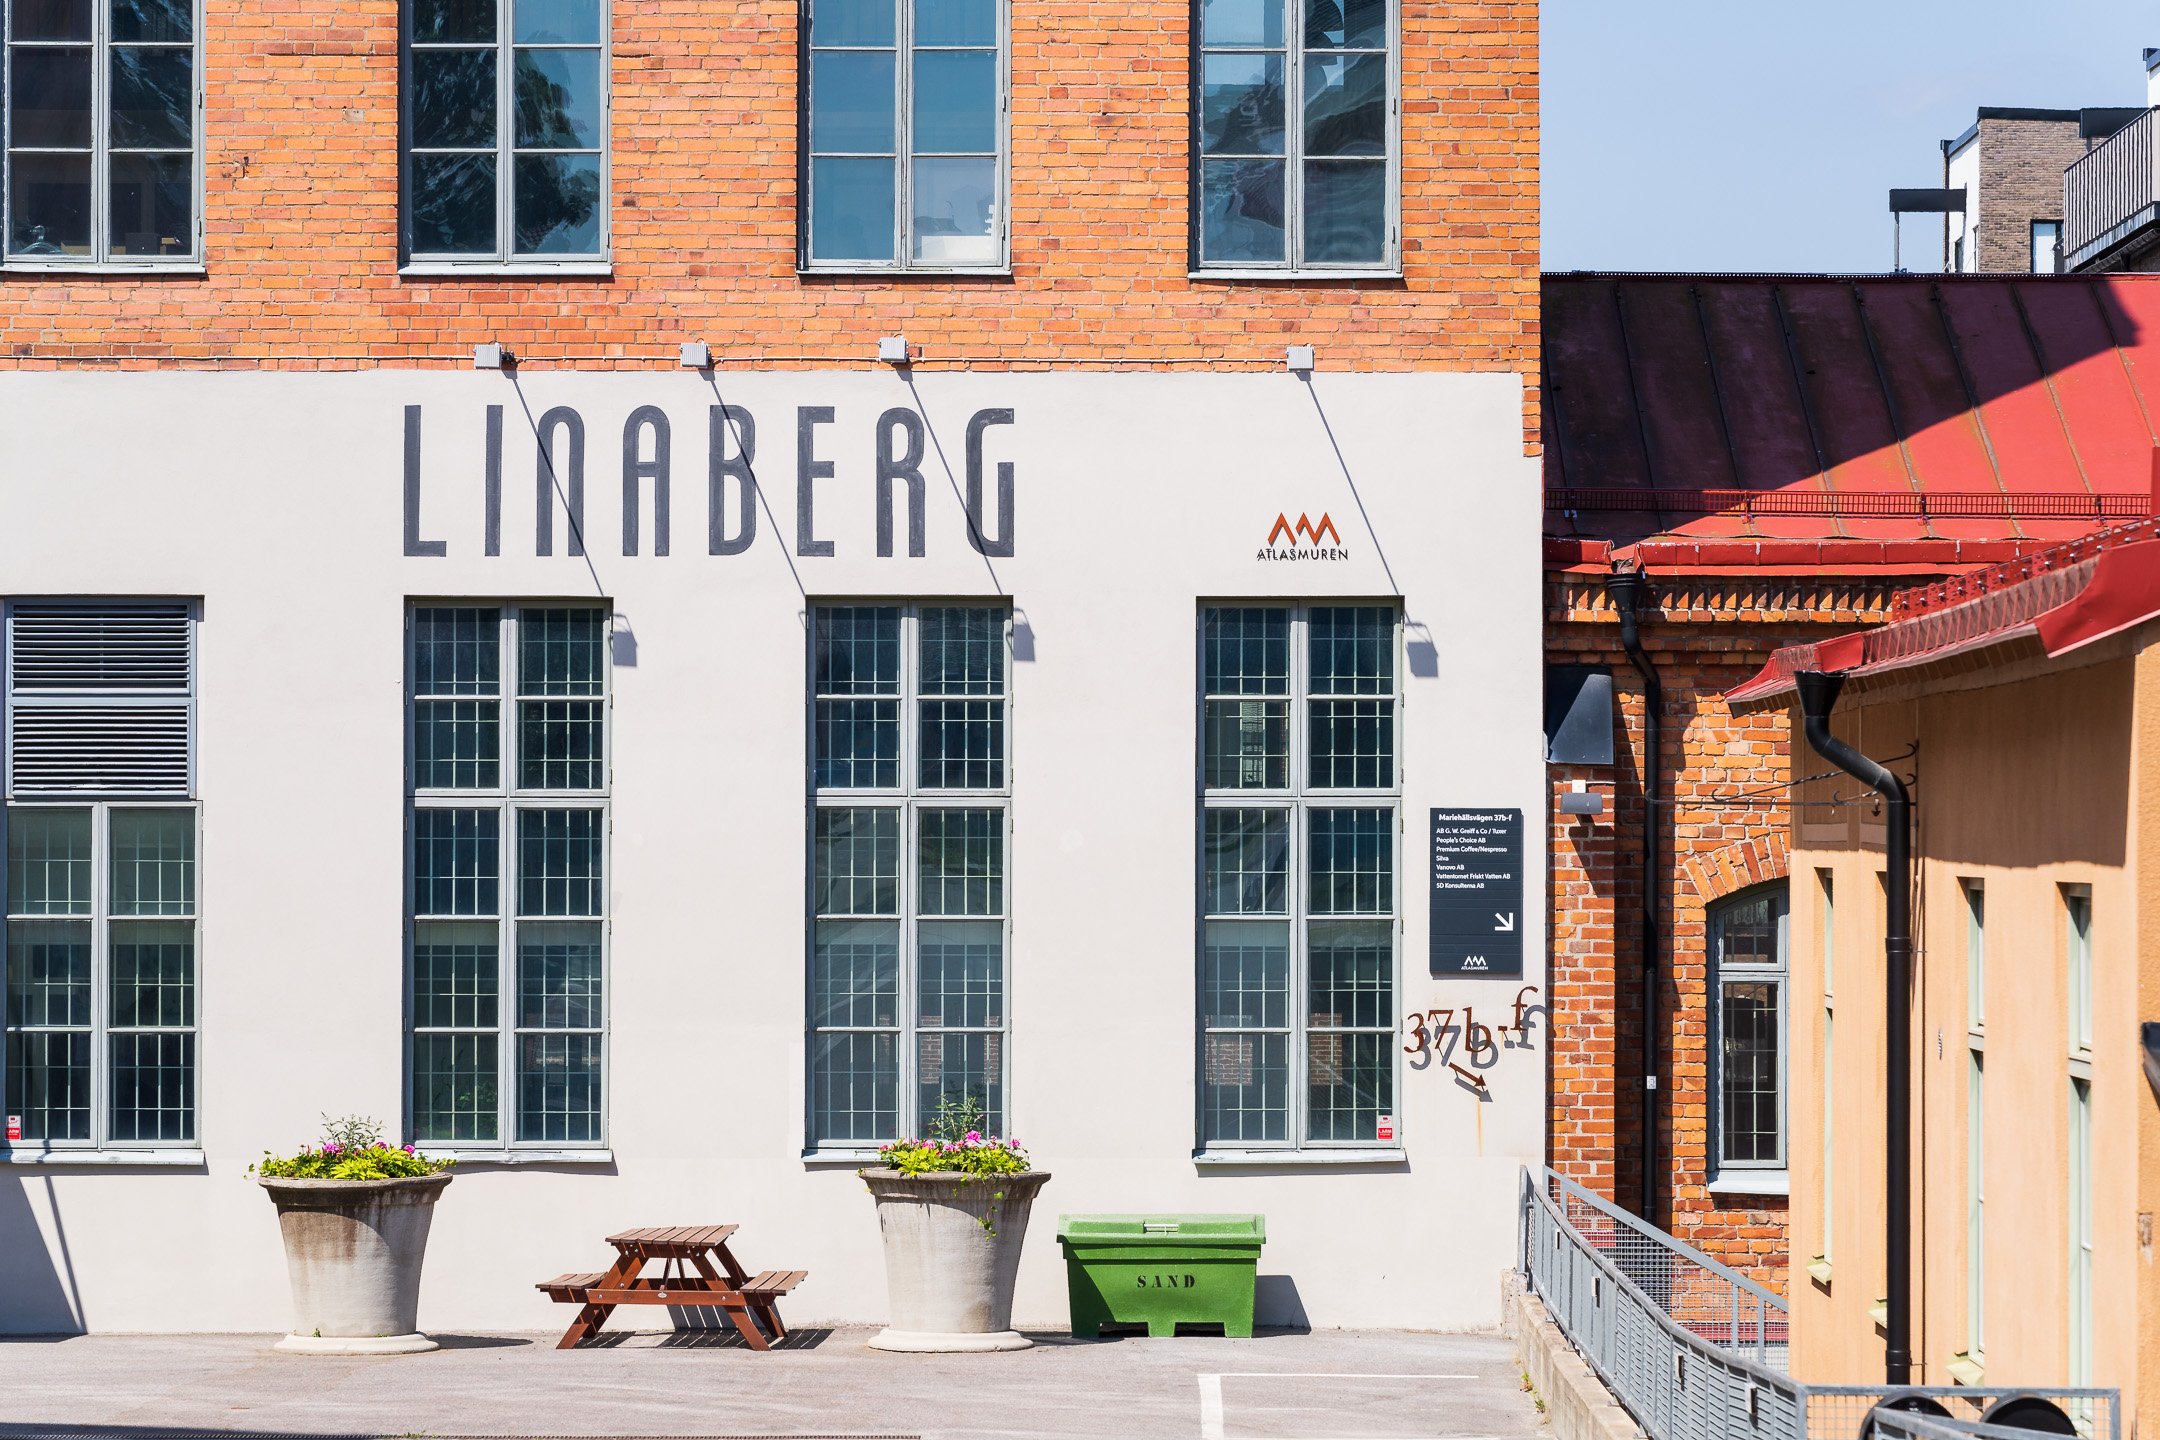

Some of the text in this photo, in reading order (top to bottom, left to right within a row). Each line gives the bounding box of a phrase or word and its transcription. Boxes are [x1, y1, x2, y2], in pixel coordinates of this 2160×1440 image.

[1256, 548, 1349, 561] ATLASMUREN
[1438, 814, 1513, 823] Mariehällsvägen 37b-f
[1137, 1274, 1196, 1289] SAND
